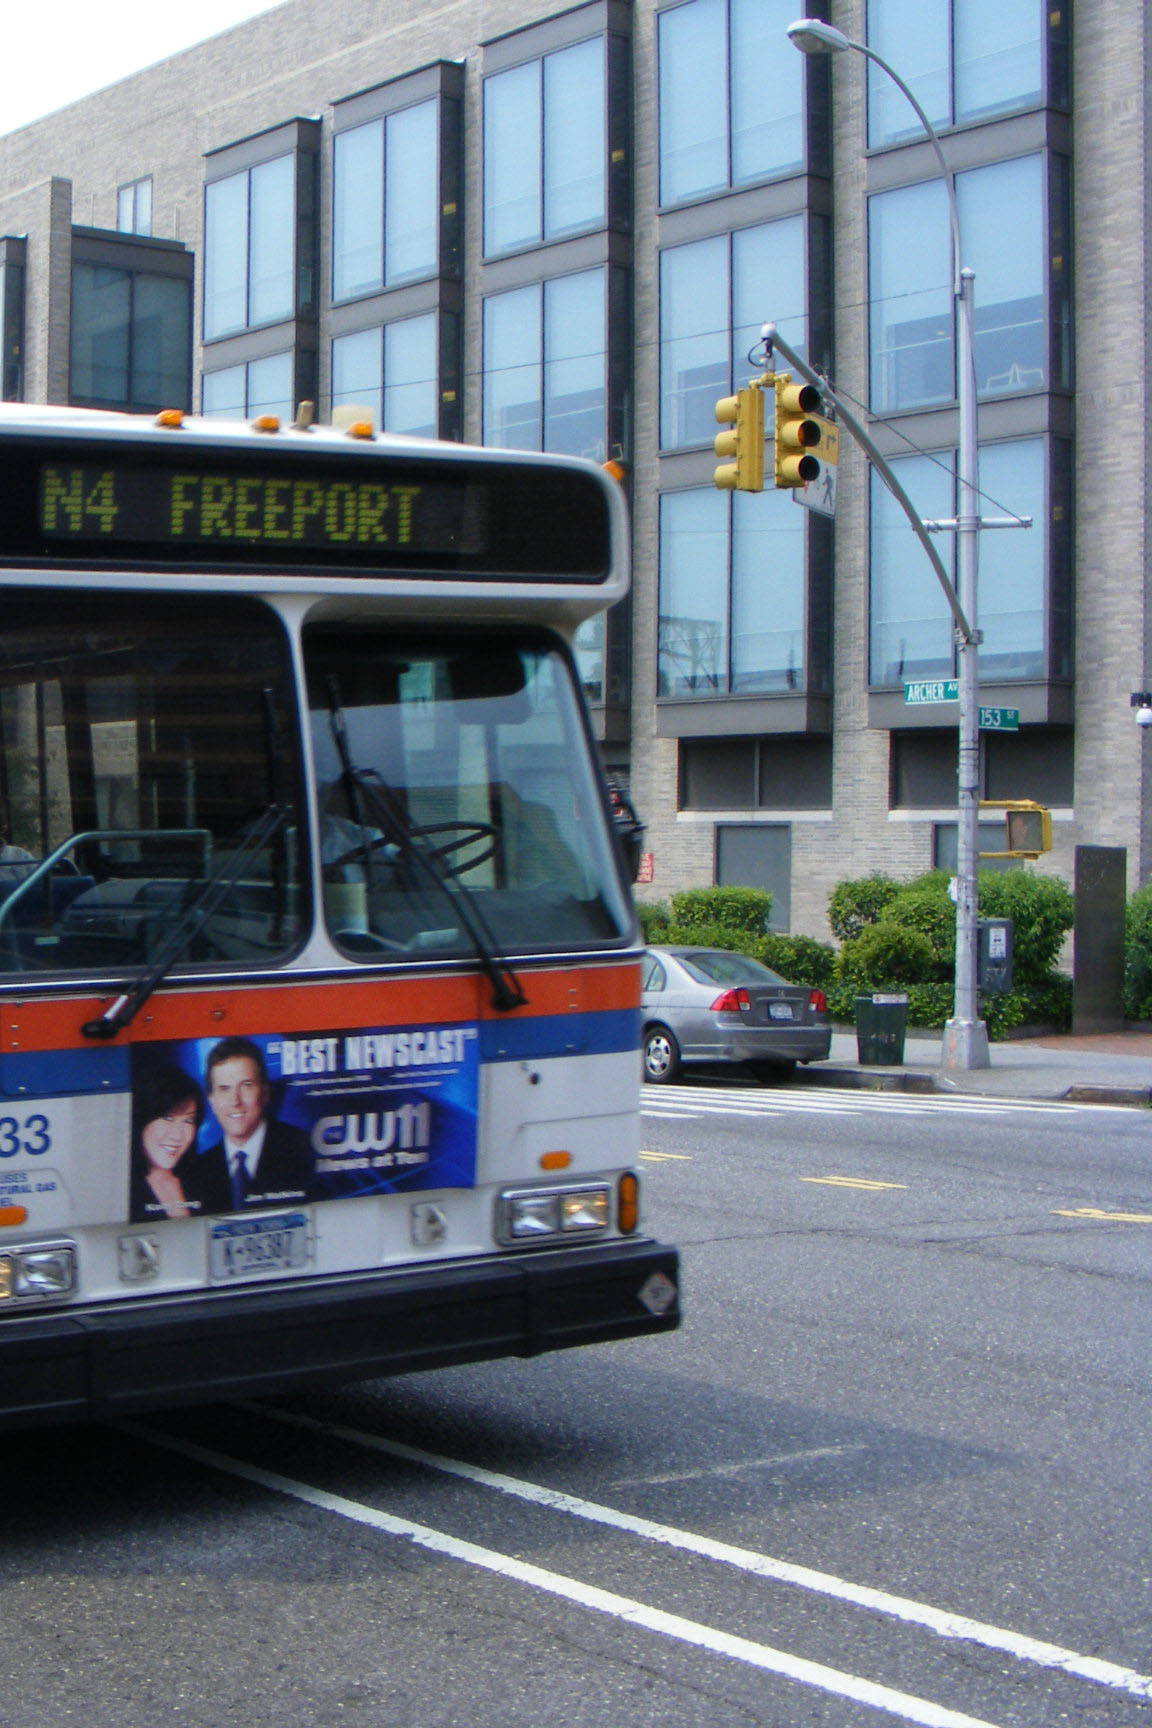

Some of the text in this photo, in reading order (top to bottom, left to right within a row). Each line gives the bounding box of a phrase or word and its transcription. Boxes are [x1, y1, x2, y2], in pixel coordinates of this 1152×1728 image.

[43, 469, 423, 545] N4 FREEPORT
[908, 684, 944, 701] ARCHER
[981, 708, 1016, 727] 153 ST
[0, 1172, 28, 1184] USES
[35, 1181, 57, 1193] GAS
